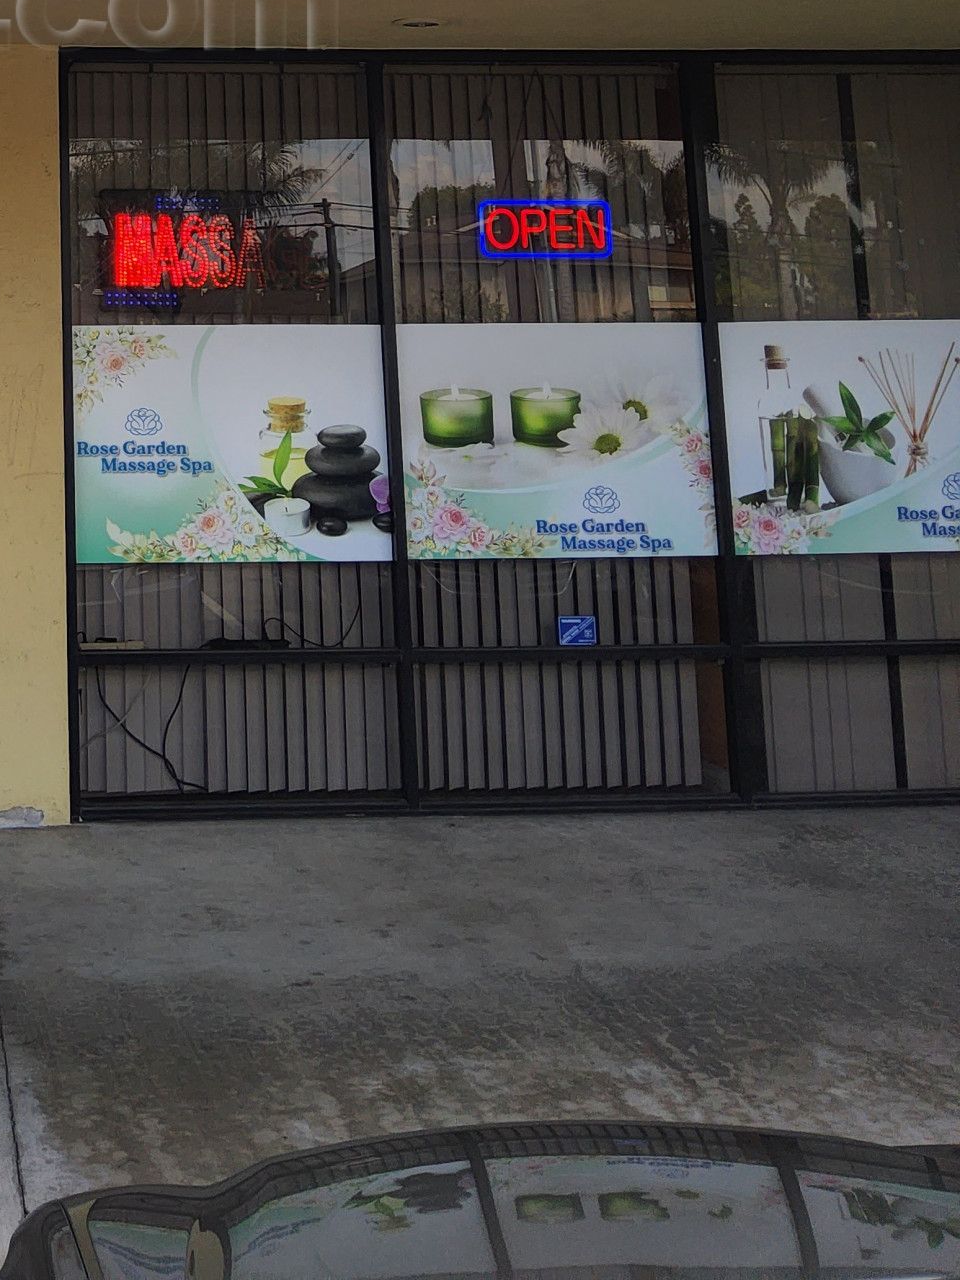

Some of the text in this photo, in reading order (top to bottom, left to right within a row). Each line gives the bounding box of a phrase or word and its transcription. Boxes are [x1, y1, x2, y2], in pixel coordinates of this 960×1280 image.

[484, 206, 607, 251] OPEN
[76, 440, 188, 456] Rose Garden
[101, 456, 214, 476] Massage Spa
[896, 505, 938, 521] Rose
[535, 517, 647, 535] Rose Garden
[560, 534, 674, 554] Massage Spa
